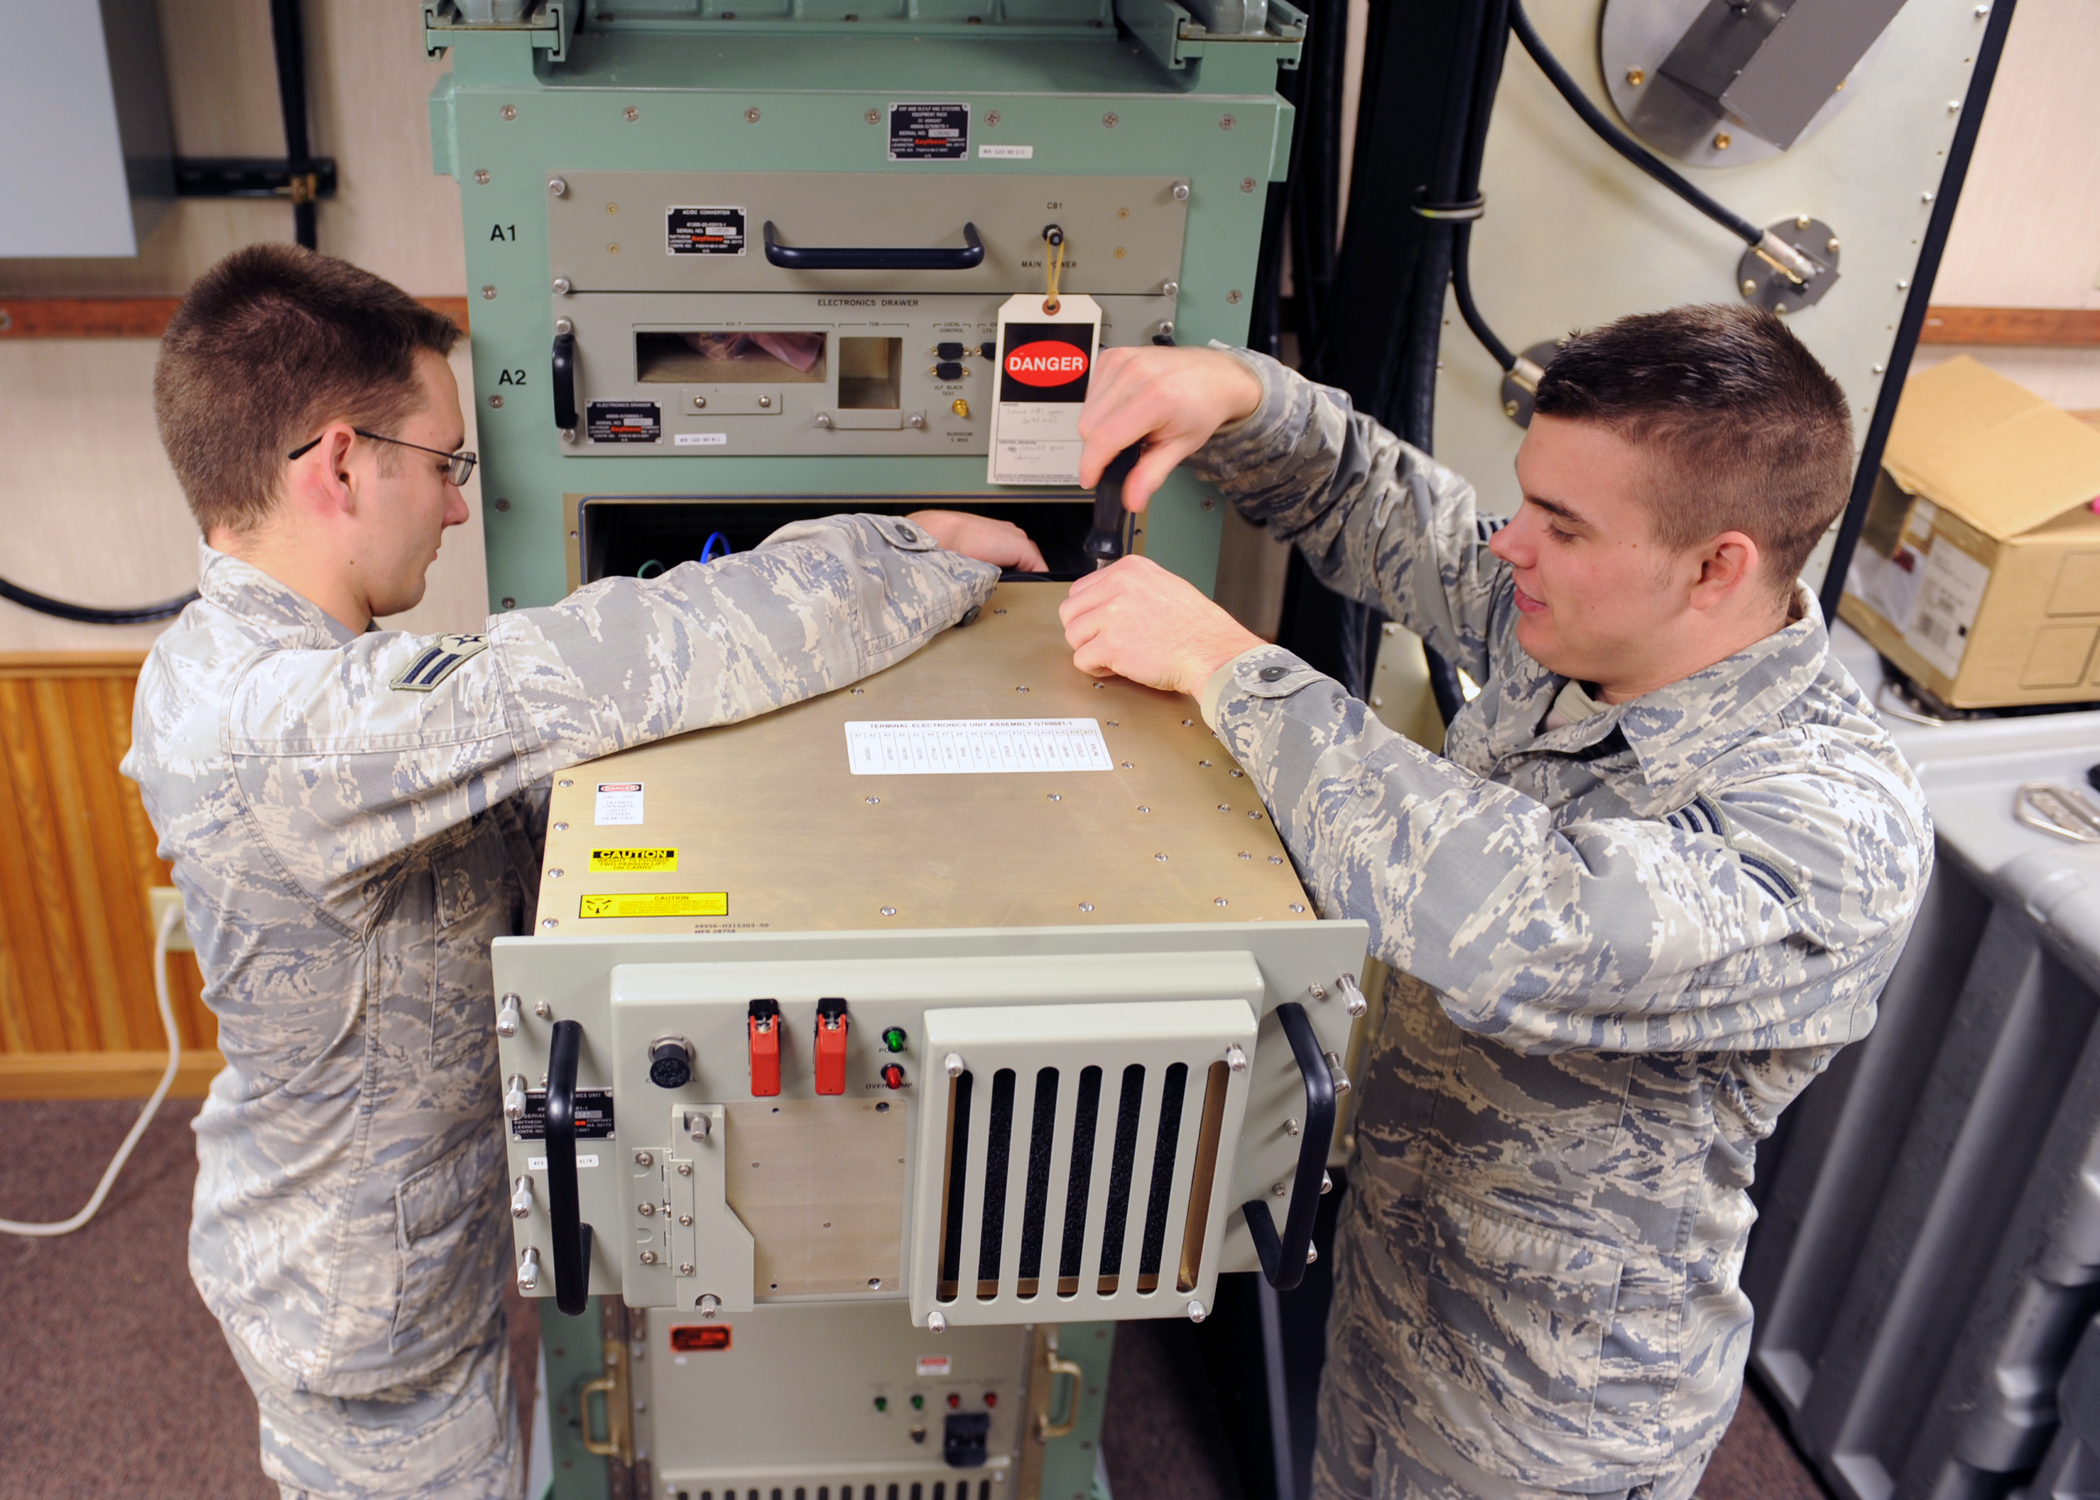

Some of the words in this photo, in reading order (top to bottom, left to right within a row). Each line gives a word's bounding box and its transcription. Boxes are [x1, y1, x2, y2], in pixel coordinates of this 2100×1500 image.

[1047, 202, 1062, 210] CB1
[490, 224, 516, 242] A1
[1009, 356, 1084, 371] DANGER
[498, 369, 527, 385] A2
[600, 850, 667, 859] CAUTION
